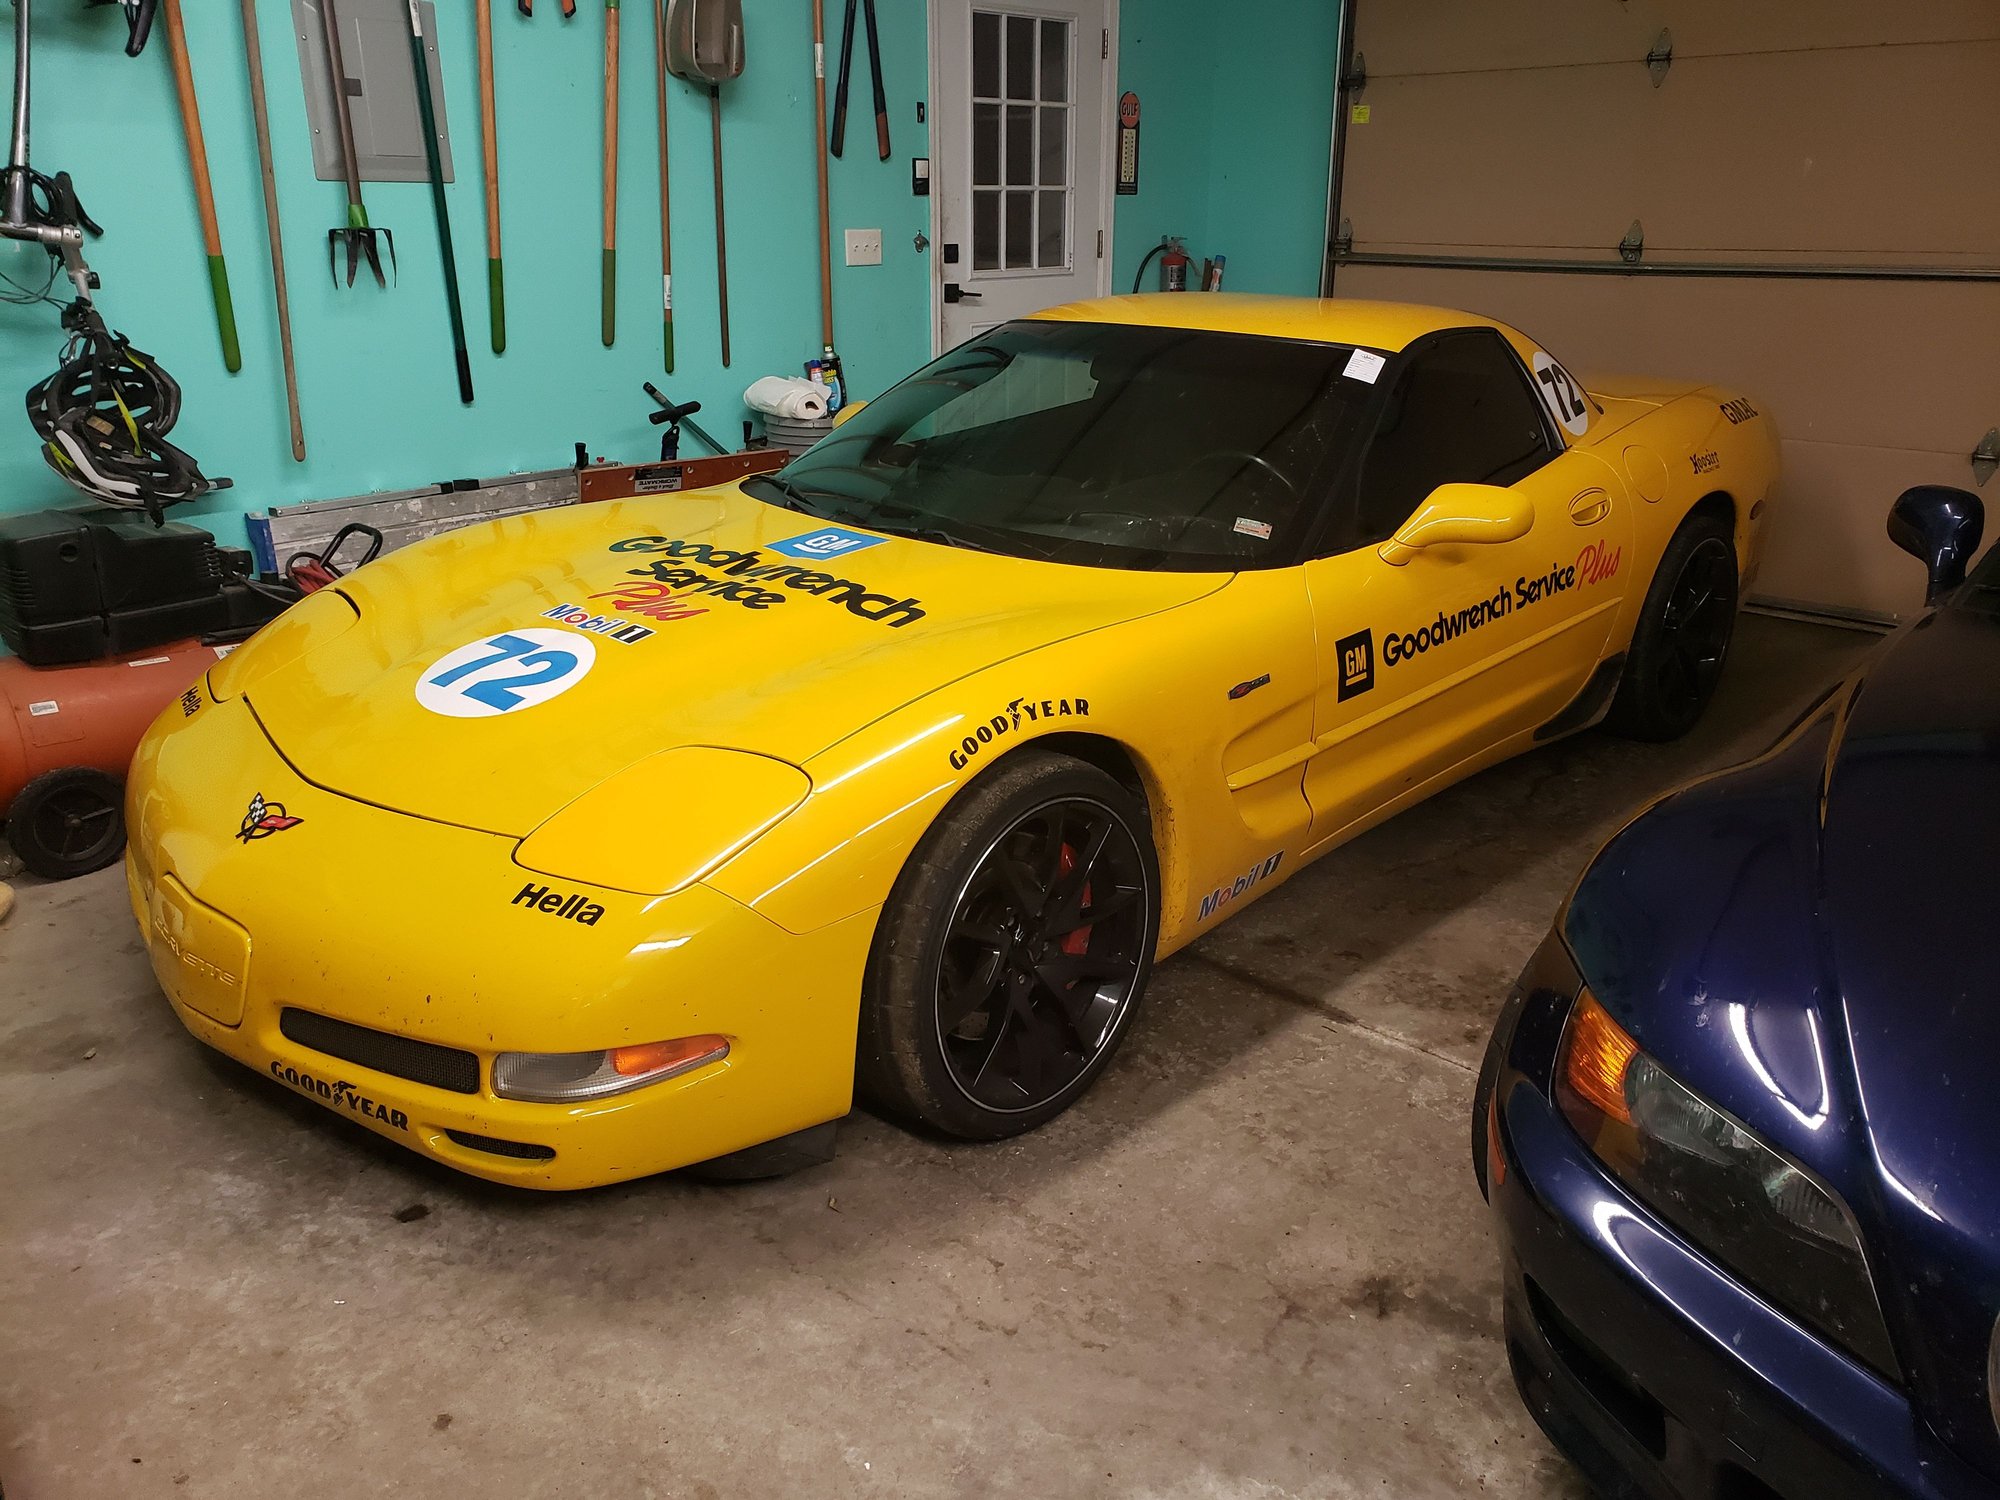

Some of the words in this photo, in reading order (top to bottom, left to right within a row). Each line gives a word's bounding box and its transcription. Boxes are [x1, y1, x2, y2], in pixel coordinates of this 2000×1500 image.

[1121, 103, 1138, 117] GULF
[1537, 364, 1586, 423] 72
[1720, 397, 1758, 425] GMAC
[802, 534, 862, 551] GM
[587, 581, 710, 621] Plus
[608, 536, 927, 628] Goodwrench
[625, 559, 787, 609] Service
[1382, 586, 1512, 667] Goodwrench
[1515, 562, 1575, 610] Service
[1575, 539, 1621, 591] Plus
[542, 603, 626, 633] Mobil
[428, 634, 578, 711] 72
[1345, 644, 1367, 678] GM
[180, 685, 202, 717] Hella
[511, 882, 605, 926] Hella
[1198, 863, 1261, 921] Mobil
